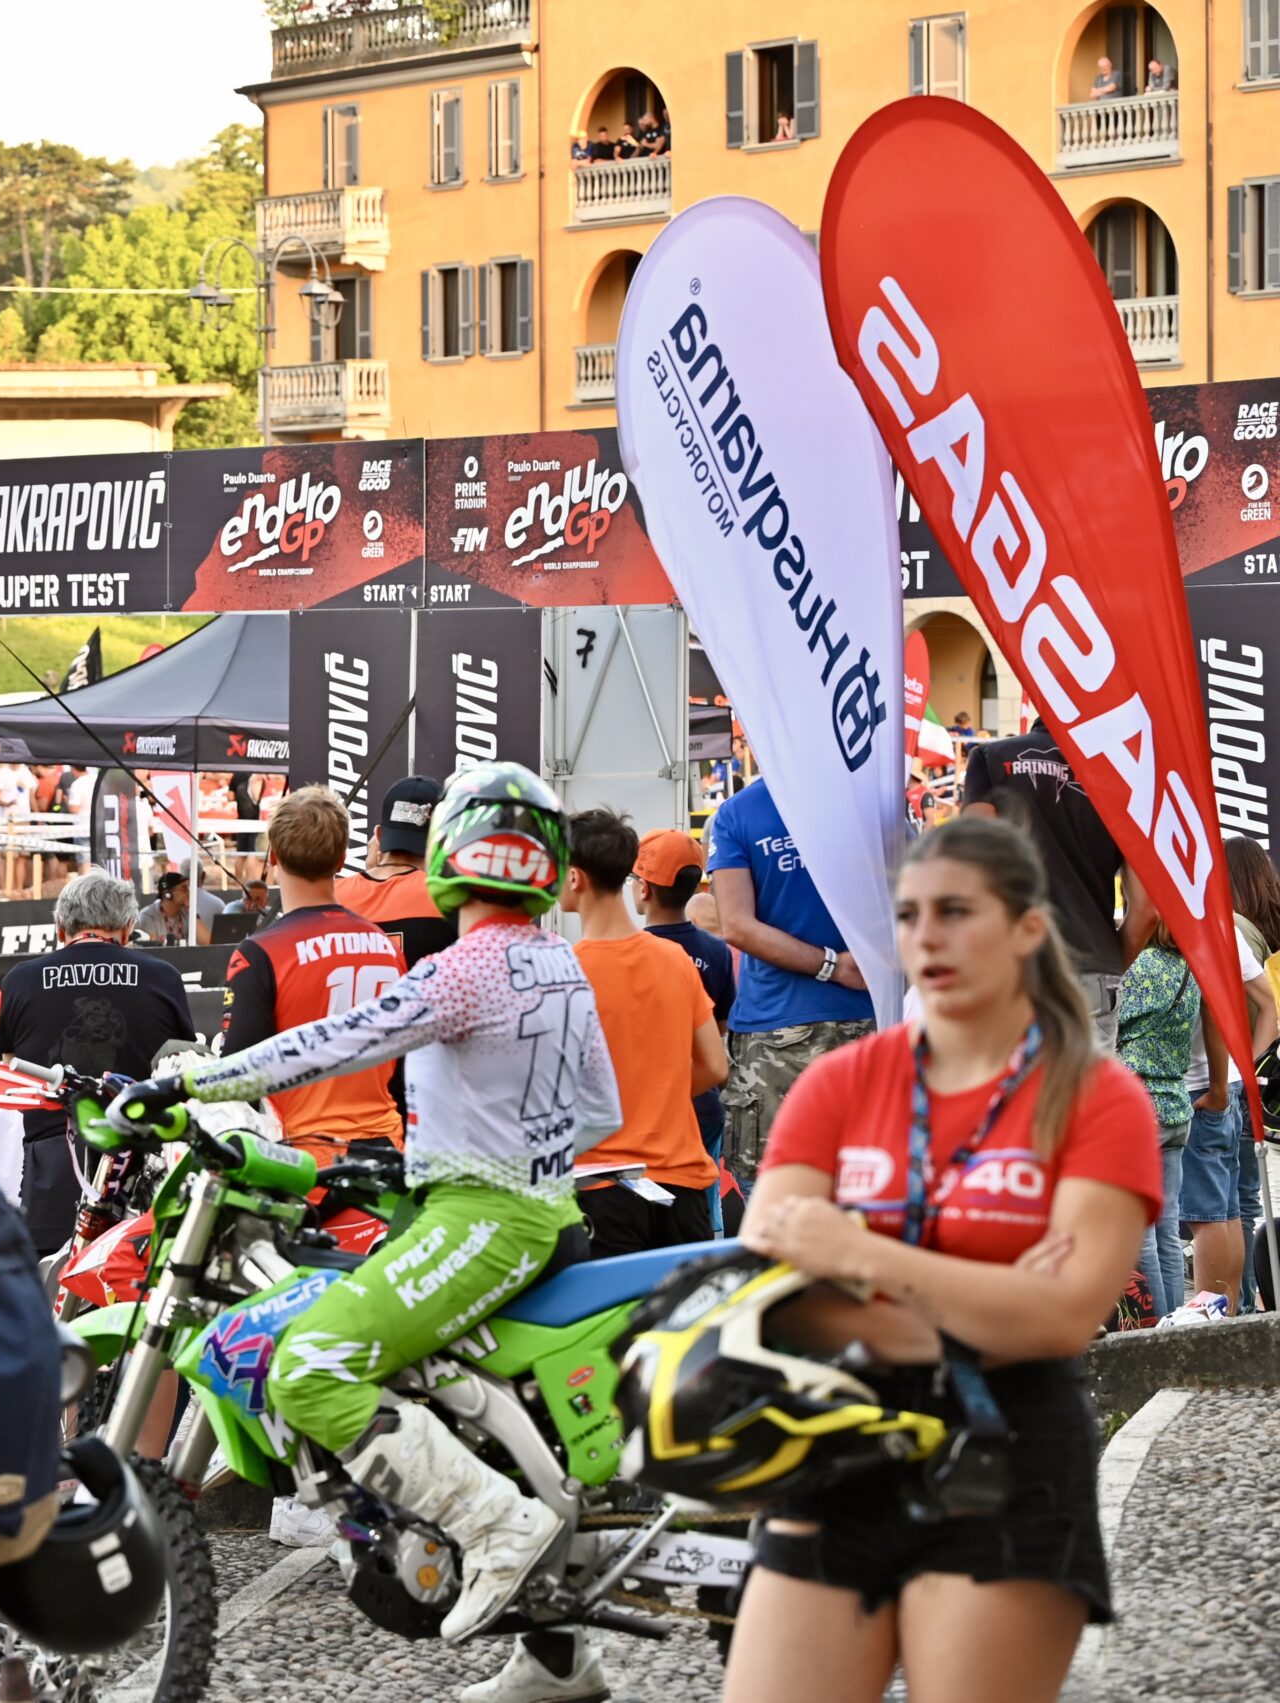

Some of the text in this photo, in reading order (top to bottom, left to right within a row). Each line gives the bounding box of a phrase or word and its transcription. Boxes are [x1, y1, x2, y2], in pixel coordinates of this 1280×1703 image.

[1238, 402, 1278, 418] RACE
[362, 460, 392, 473] RACE
[507, 459, 561, 473] Paulo Duarte
[223, 472, 275, 484] Paulo Duarte
[358, 478, 390, 491] GOOD
[455, 481, 487, 498] PRIME
[455, 497, 487, 510] STADIUM
[1240, 508, 1271, 521] GREEN
[453, 527, 489, 552] FIM
[544, 562, 561, 570] WORLD
[562, 561, 600, 570] CHAMPIONSHIP
[67, 573, 130, 607] TEST
[363, 584, 405, 602] START
[430, 584, 471, 602] START
[1003, 760, 1069, 781] TRAINING
[455, 840, 550, 882] GIVI
[43, 963, 138, 990] PAVONI
[396, 1219, 500, 1309] Kawasaki
